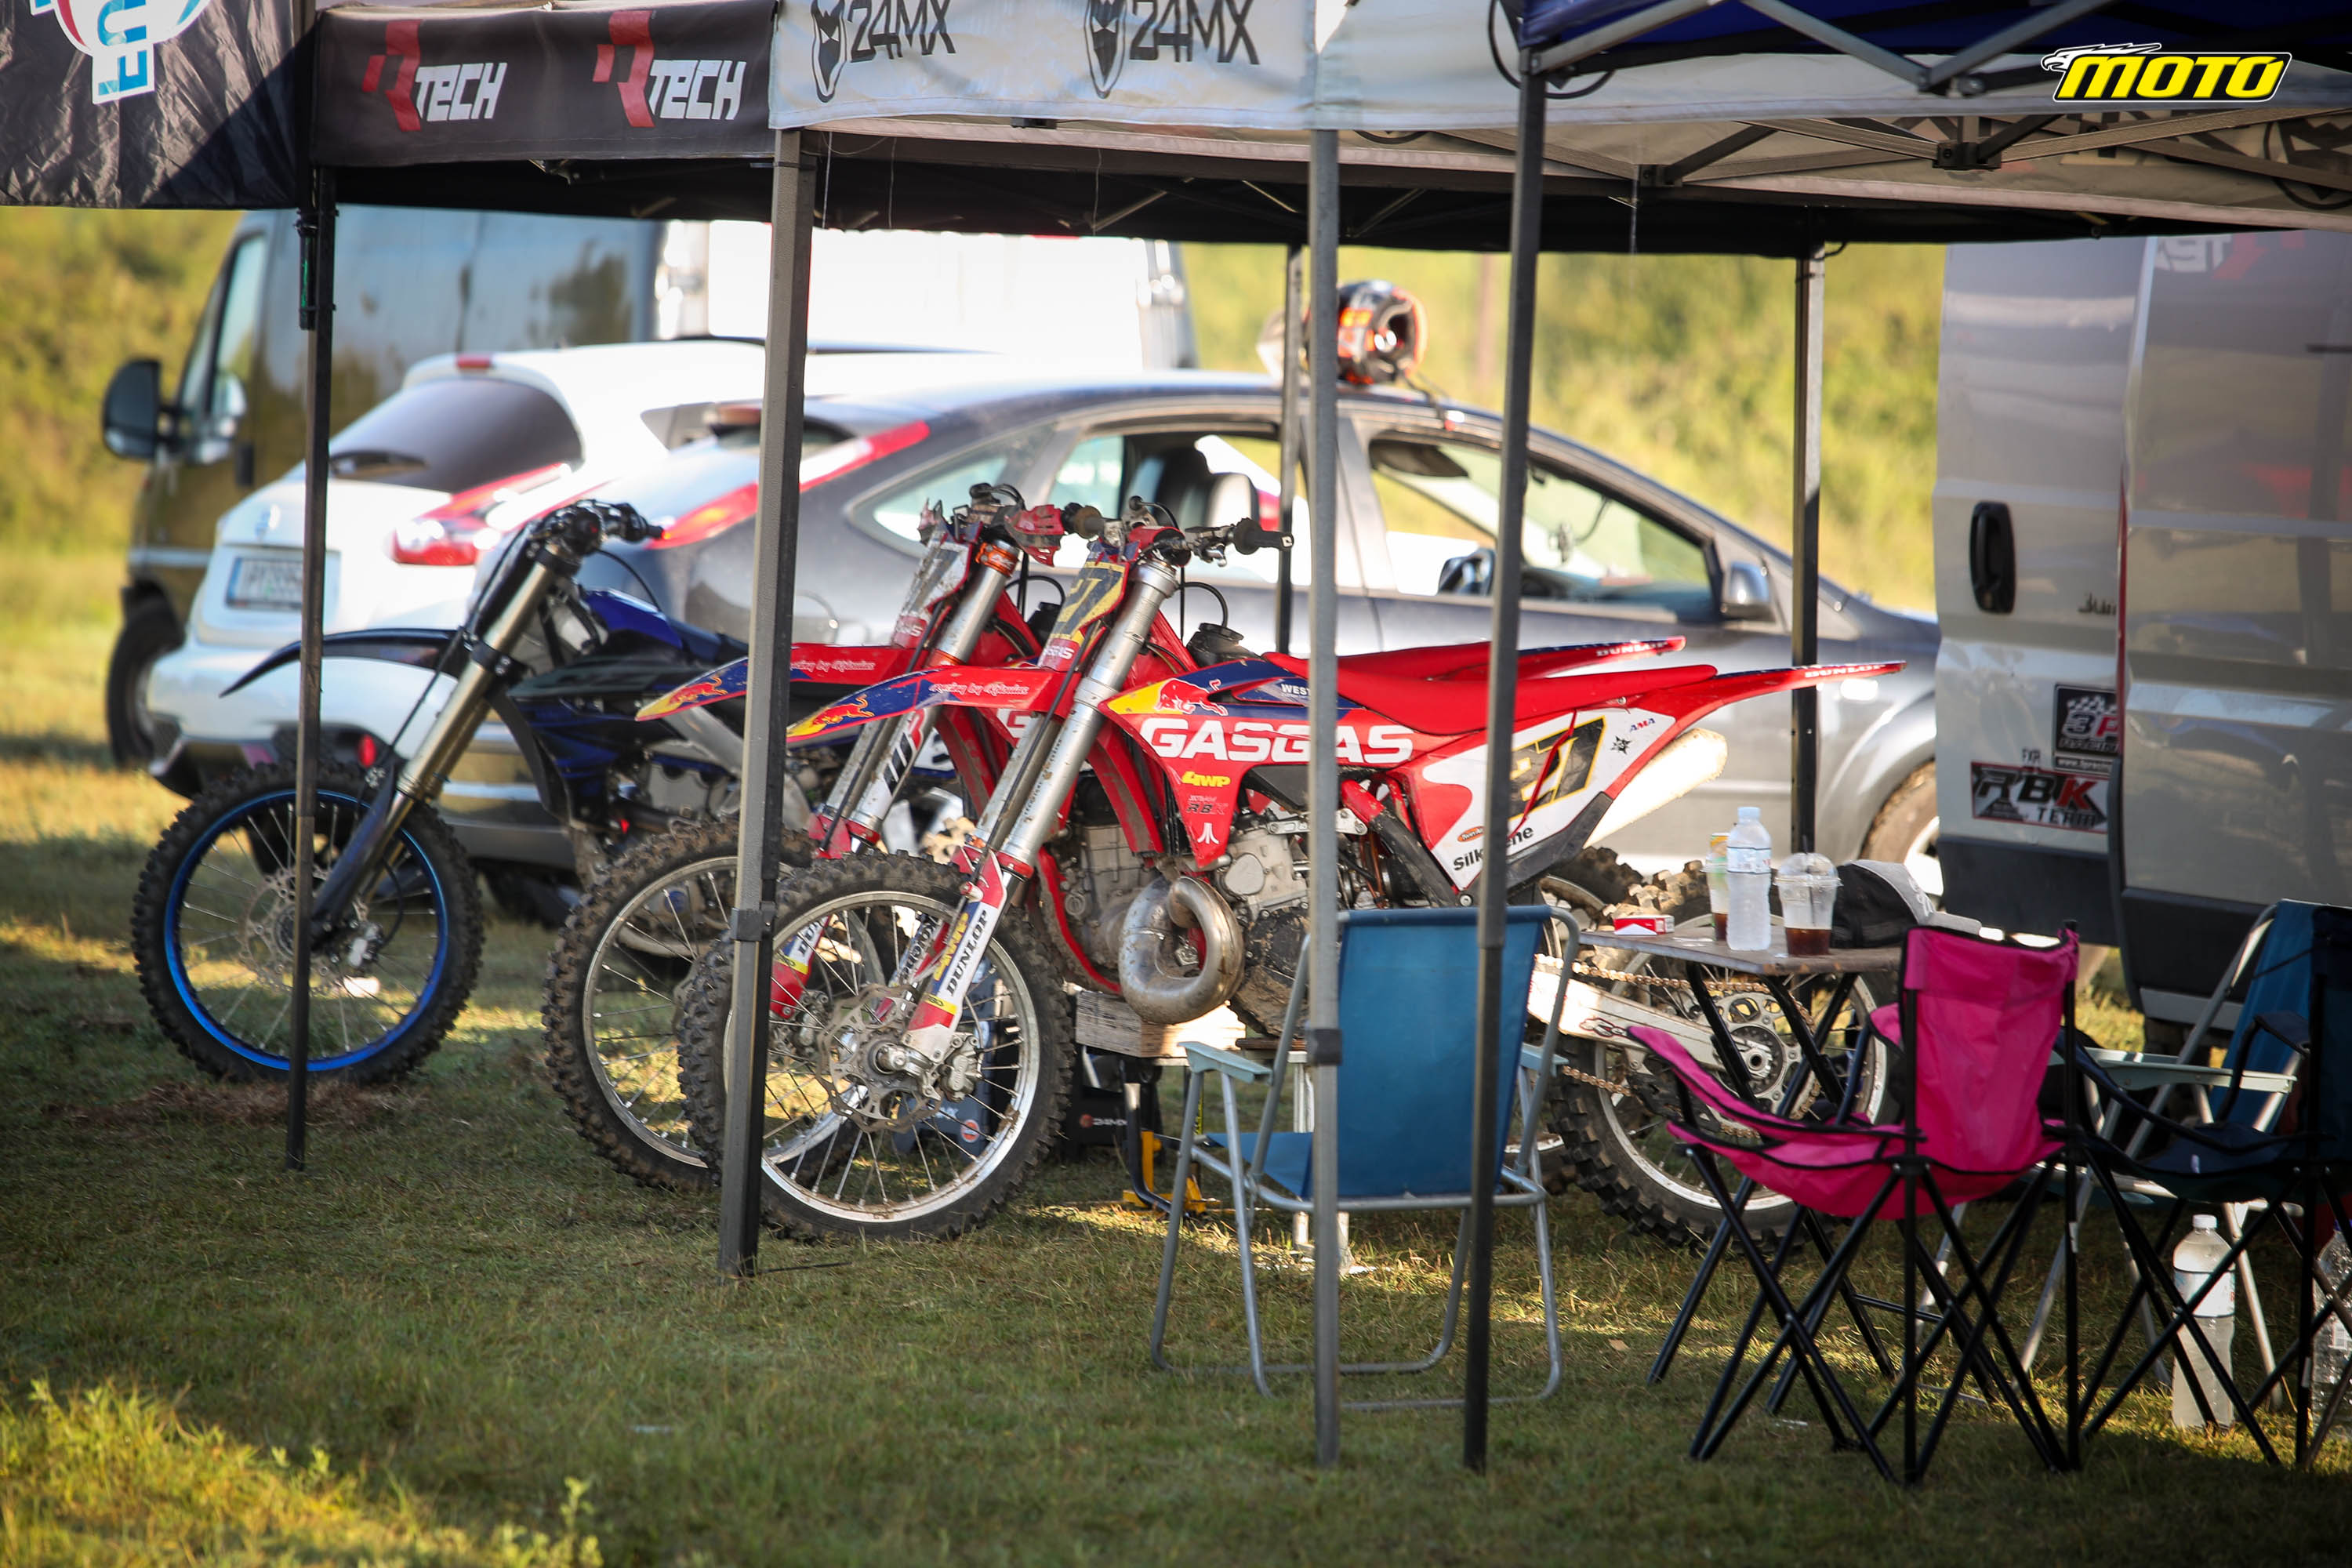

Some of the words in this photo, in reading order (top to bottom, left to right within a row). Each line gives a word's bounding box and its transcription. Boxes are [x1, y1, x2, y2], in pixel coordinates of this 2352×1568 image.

[848, 0, 956, 62] 24MX
[1130, 0, 1259, 64] 24MX
[1139, 717, 1414, 764] GASGAS
[947, 910, 987, 996] DUNLOP
